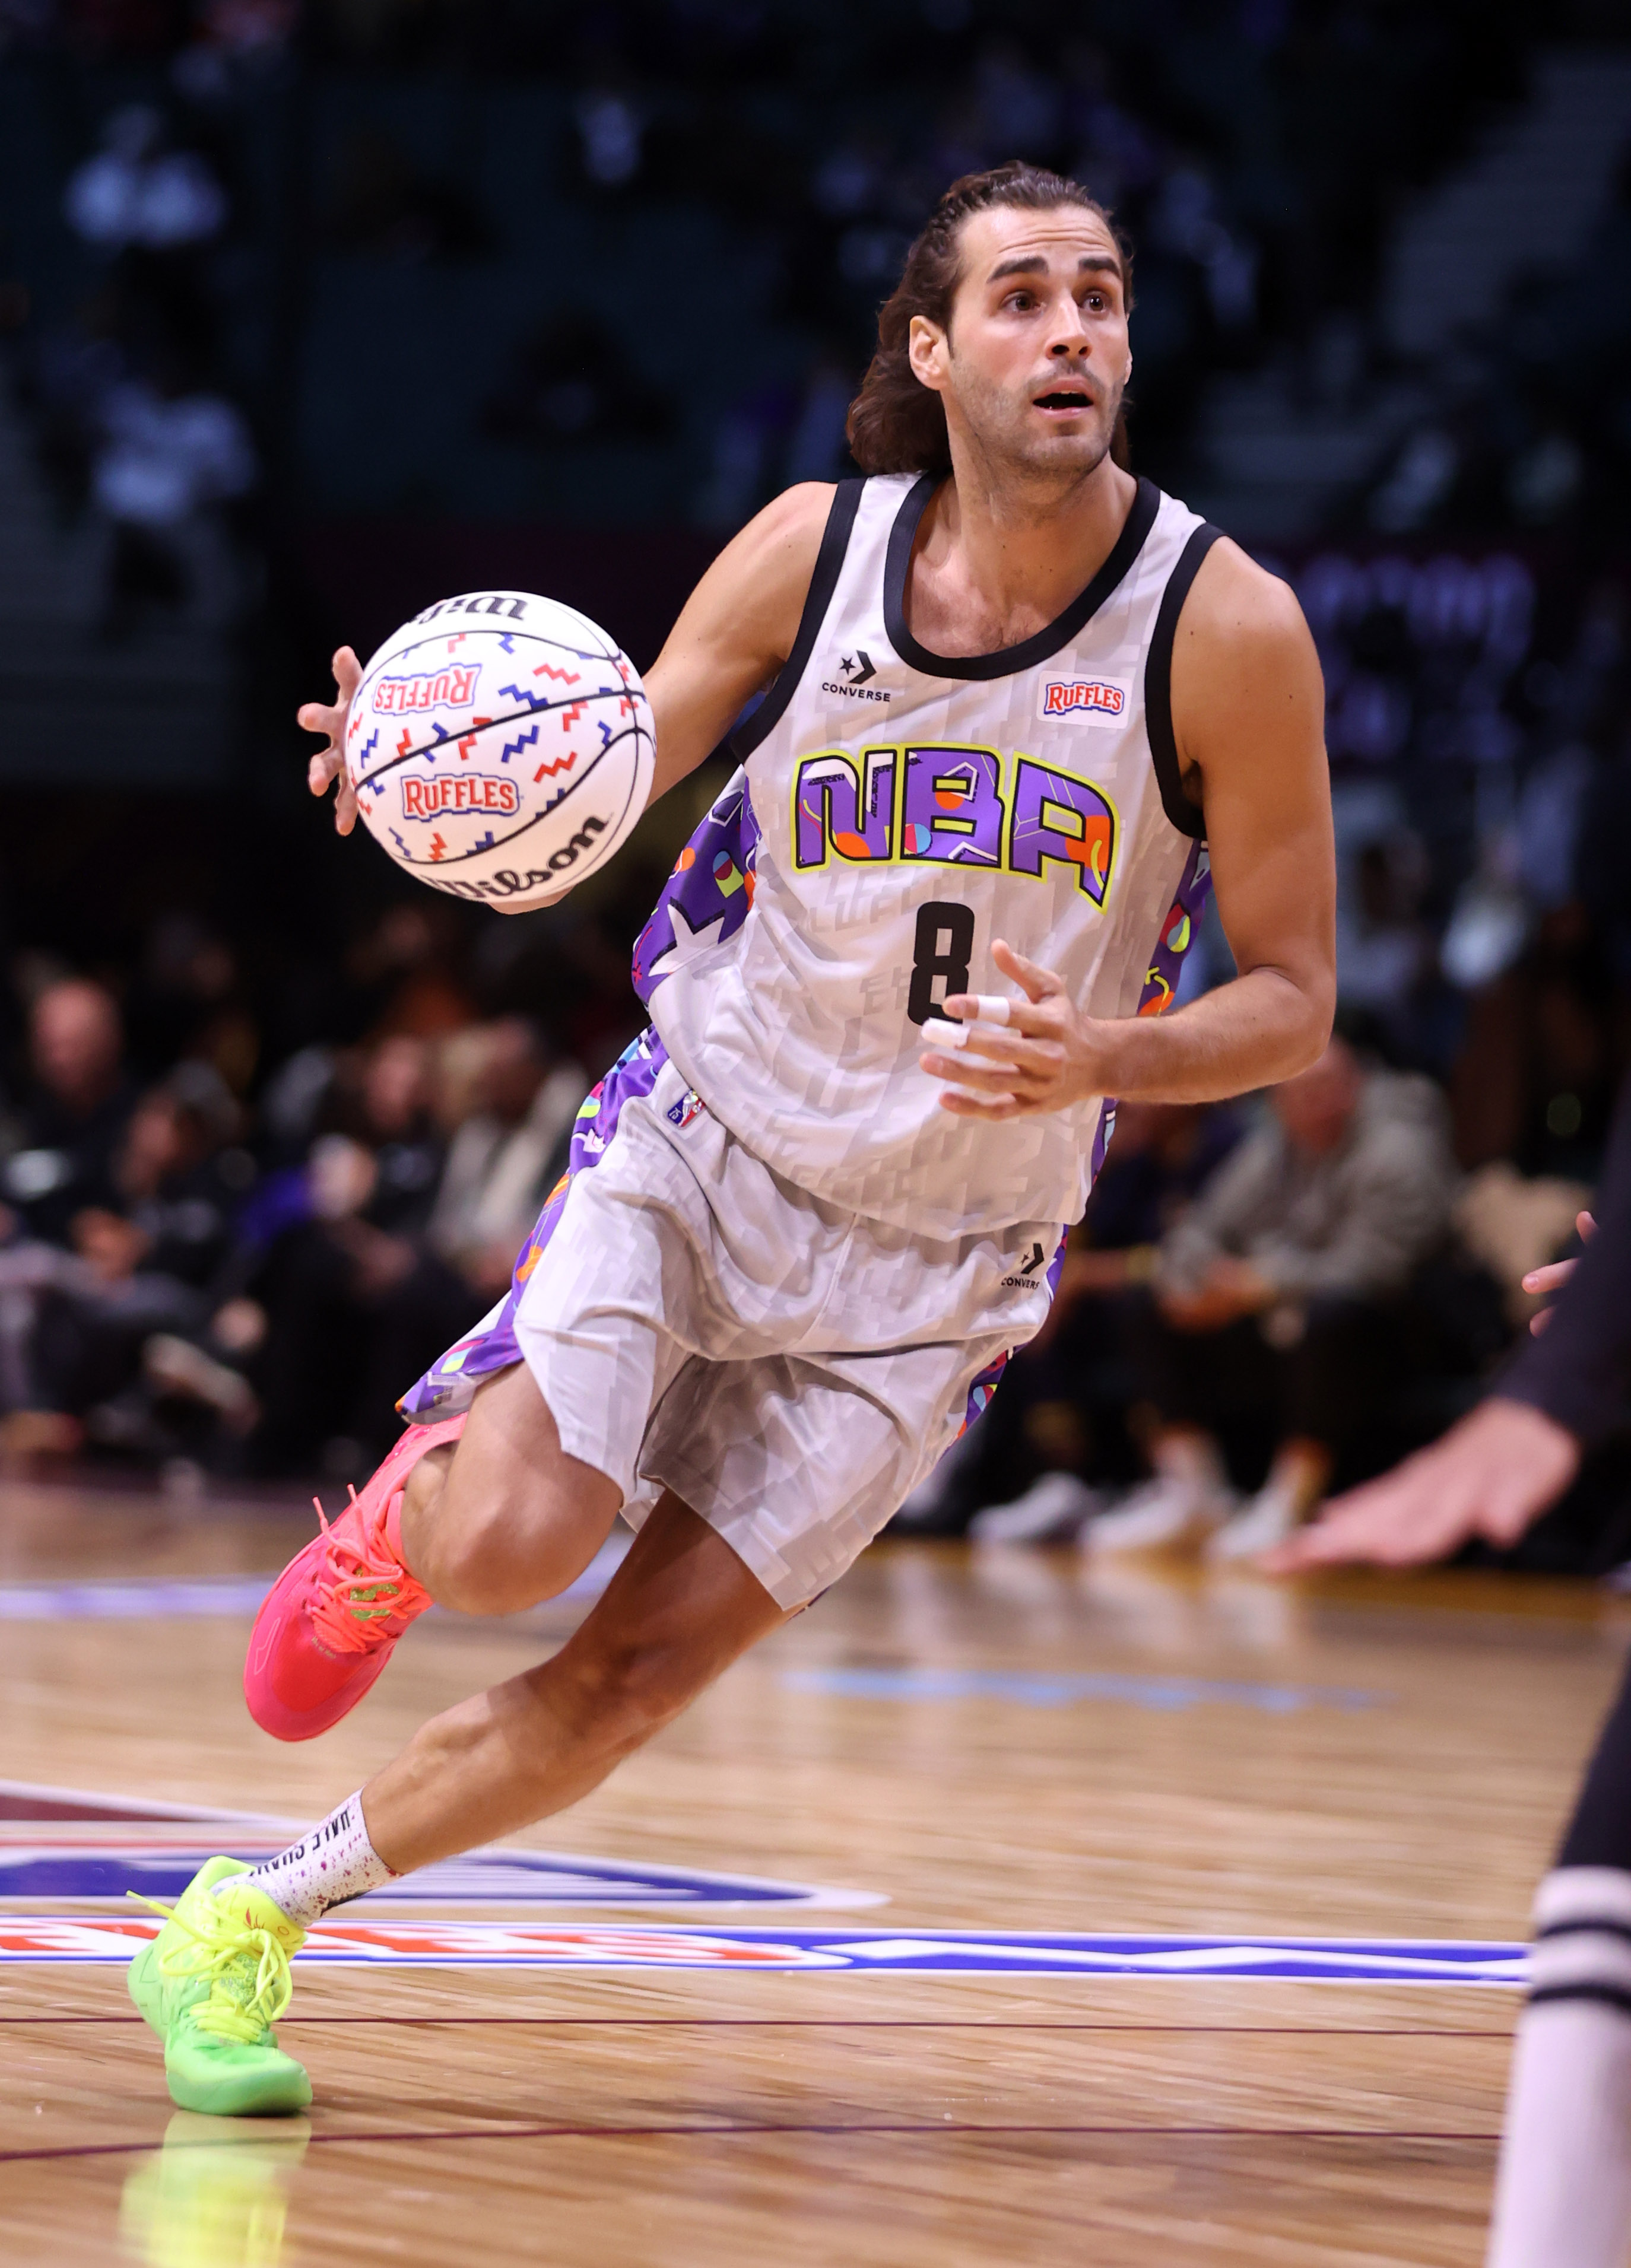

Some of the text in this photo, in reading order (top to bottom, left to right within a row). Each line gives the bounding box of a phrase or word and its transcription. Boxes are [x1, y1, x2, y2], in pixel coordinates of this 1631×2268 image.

[375, 669, 475, 710] RUFFLES
[822, 682, 891, 702] CONVERSE
[1047, 684, 1122, 711] RUFFLES
[404, 777, 516, 817] RUFFLES
[792, 744, 1119, 913] NBA
[420, 817, 610, 898] Wilson
[907, 901, 975, 1027] 8
[668, 1107, 682, 1120] 75
